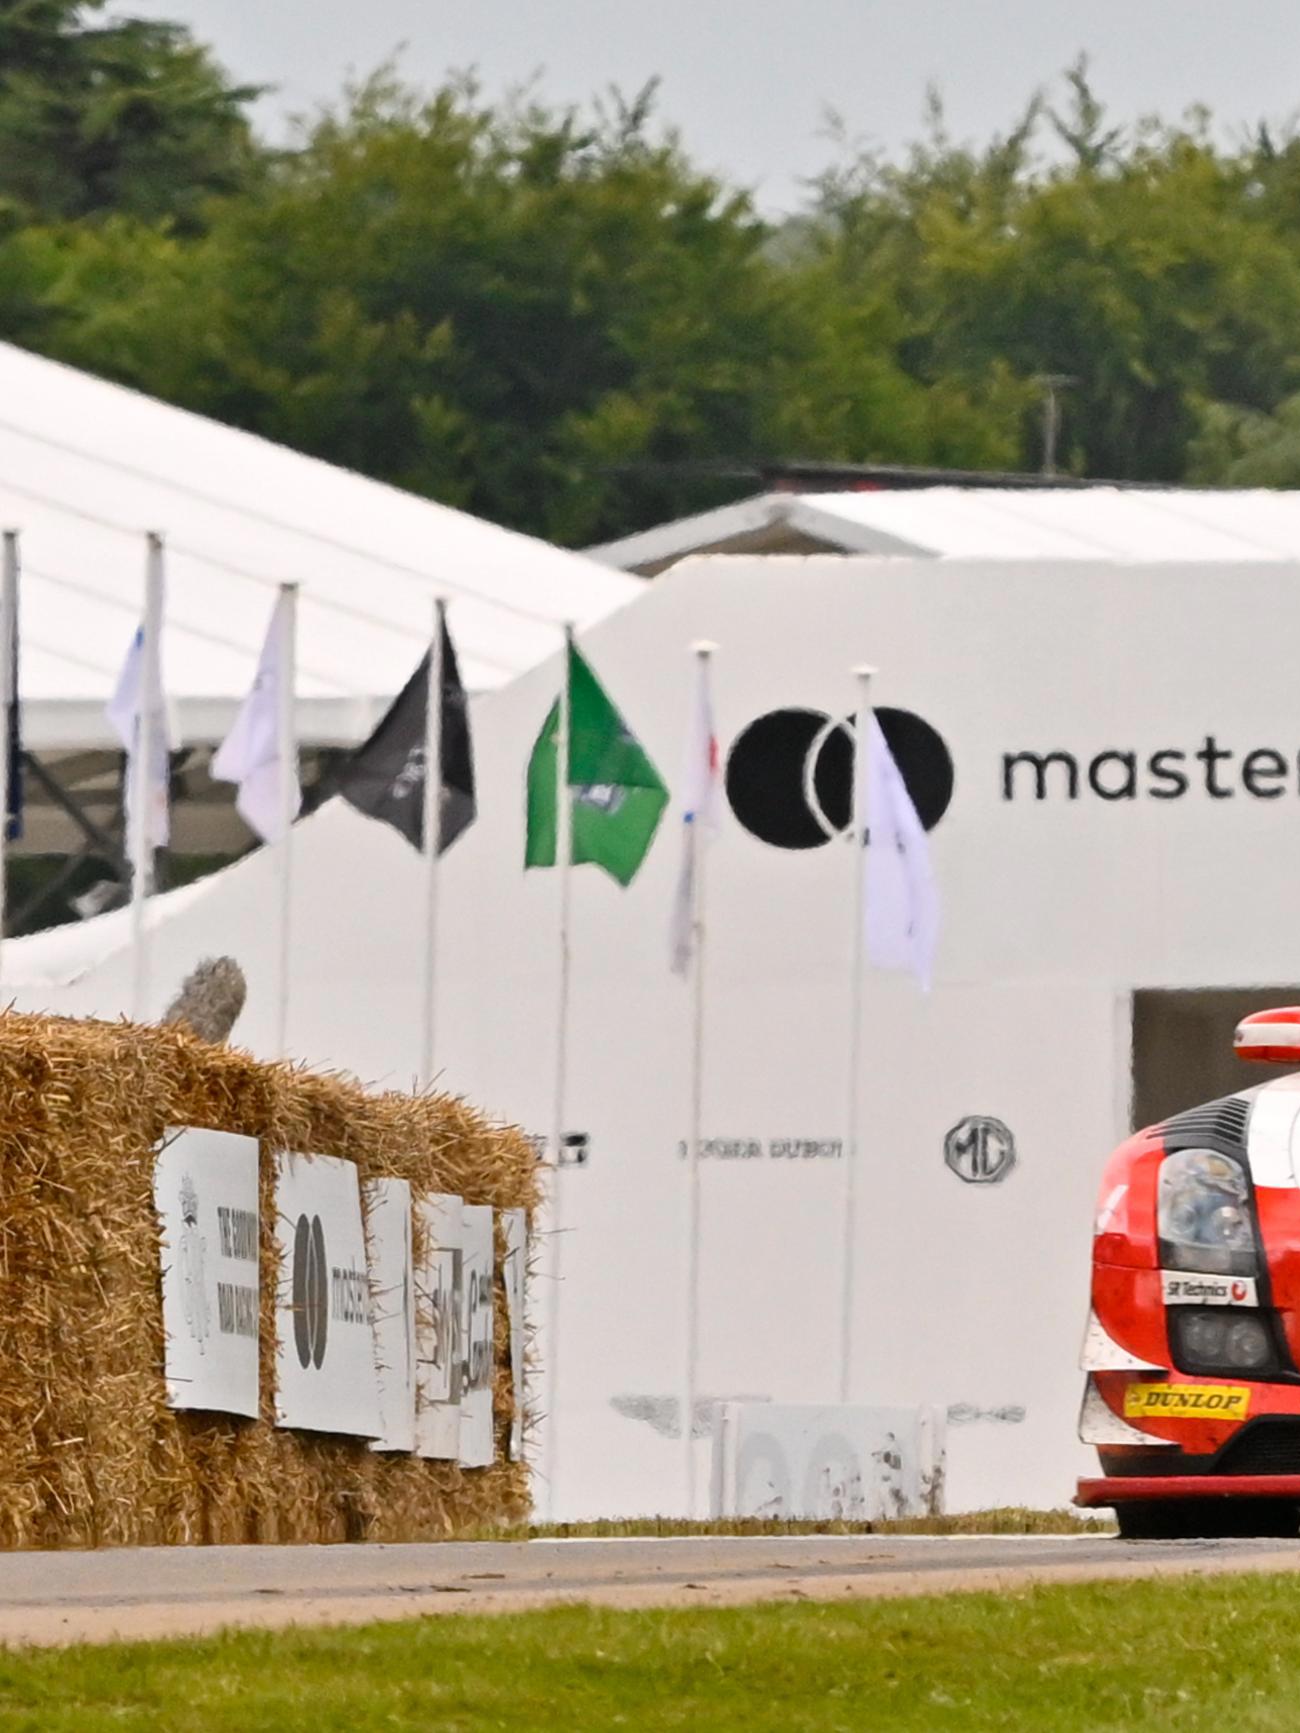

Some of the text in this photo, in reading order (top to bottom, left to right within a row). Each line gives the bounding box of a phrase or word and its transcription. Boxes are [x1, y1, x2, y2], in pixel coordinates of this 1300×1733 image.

[950, 1121, 1011, 1180] MG
[1167, 1281, 1228, 1297] SR Technics
[1144, 1391, 1243, 1409] DUNLOP
